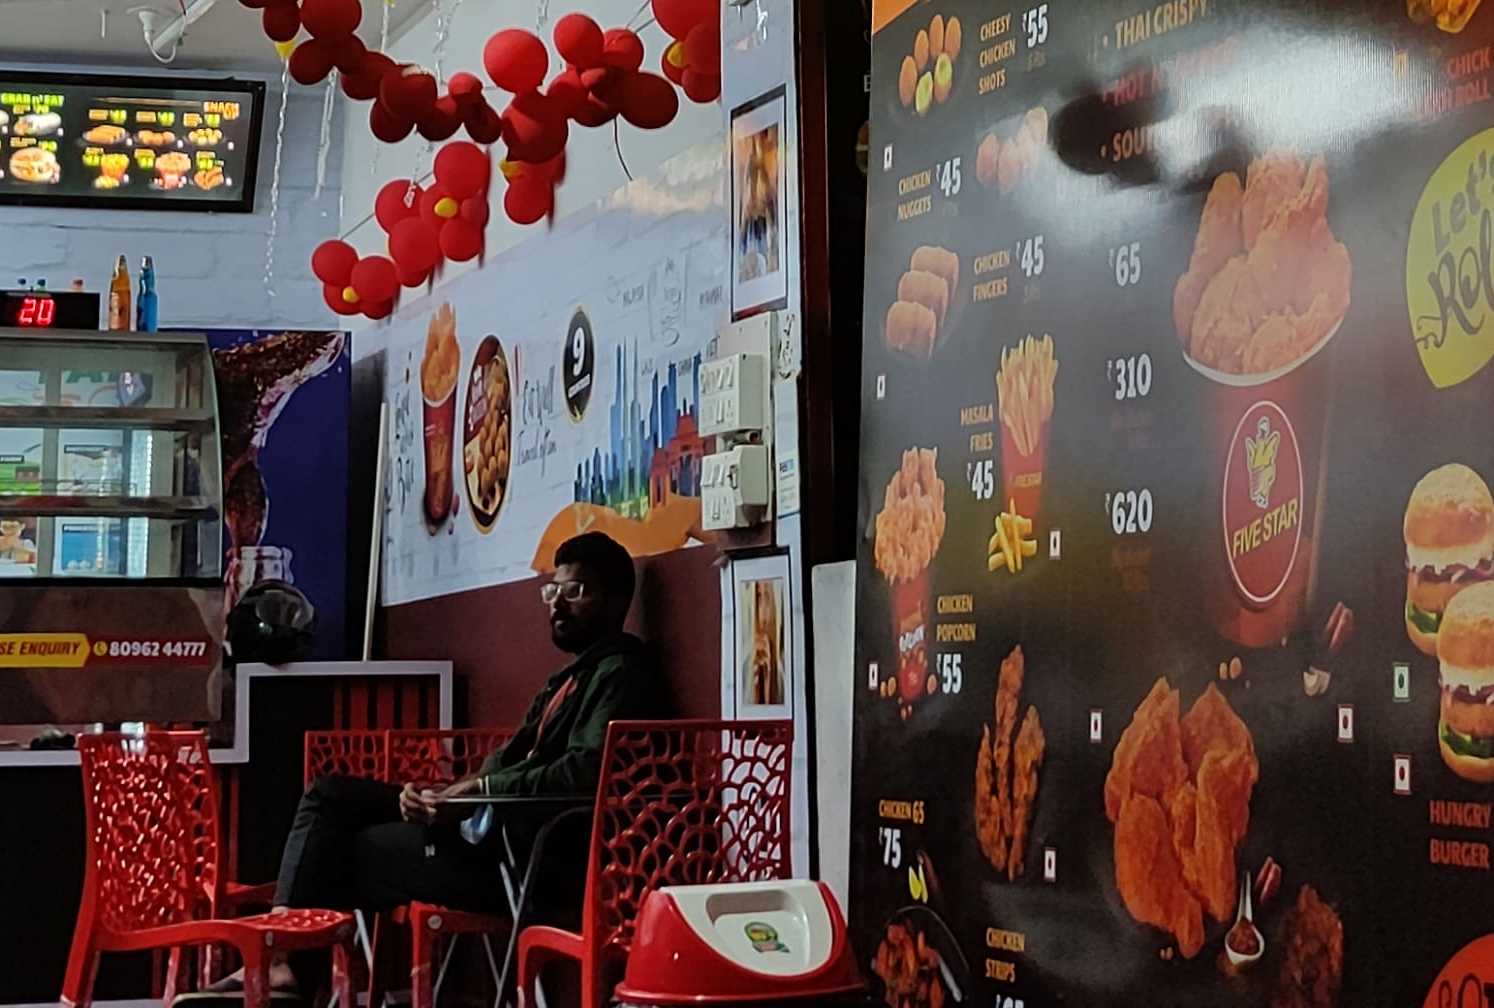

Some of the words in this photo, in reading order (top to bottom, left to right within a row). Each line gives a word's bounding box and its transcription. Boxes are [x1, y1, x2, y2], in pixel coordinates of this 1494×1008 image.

[980, 12, 1012, 41] CHEESY
[1115, 10, 1150, 49] THAI
[979, 39, 1016, 68] CHICKEN
[979, 69, 1006, 95] SHOTS
[898, 169, 931, 195] CHICKEN
[897, 199, 931, 222] NUGGETS
[974, 251, 1011, 275] CHICKEN
[973, 279, 1009, 302] FINGERS
[18, 298, 55, 326] 20
[960, 403, 994, 427] MASALA
[970, 432, 993, 453] FRIES
[1233, 517, 1262, 559] FIVE
[1263, 497, 1298, 542] STAR
[937, 594, 973, 613] CHICKEN
[936, 623, 976, 642] POPCORN
[19, 641, 82, 656] ENQUIRY
[109, 641, 159, 657] 80962
[162, 642, 206, 657] 44777
[879, 799, 911, 820] CHICKEN
[1429, 800, 1491, 830] HUNGRY
[1430, 839, 1490, 870] BURGER
[986, 927, 1025, 952] CHICKEN
[985, 958, 1015, 983] STRIPS
